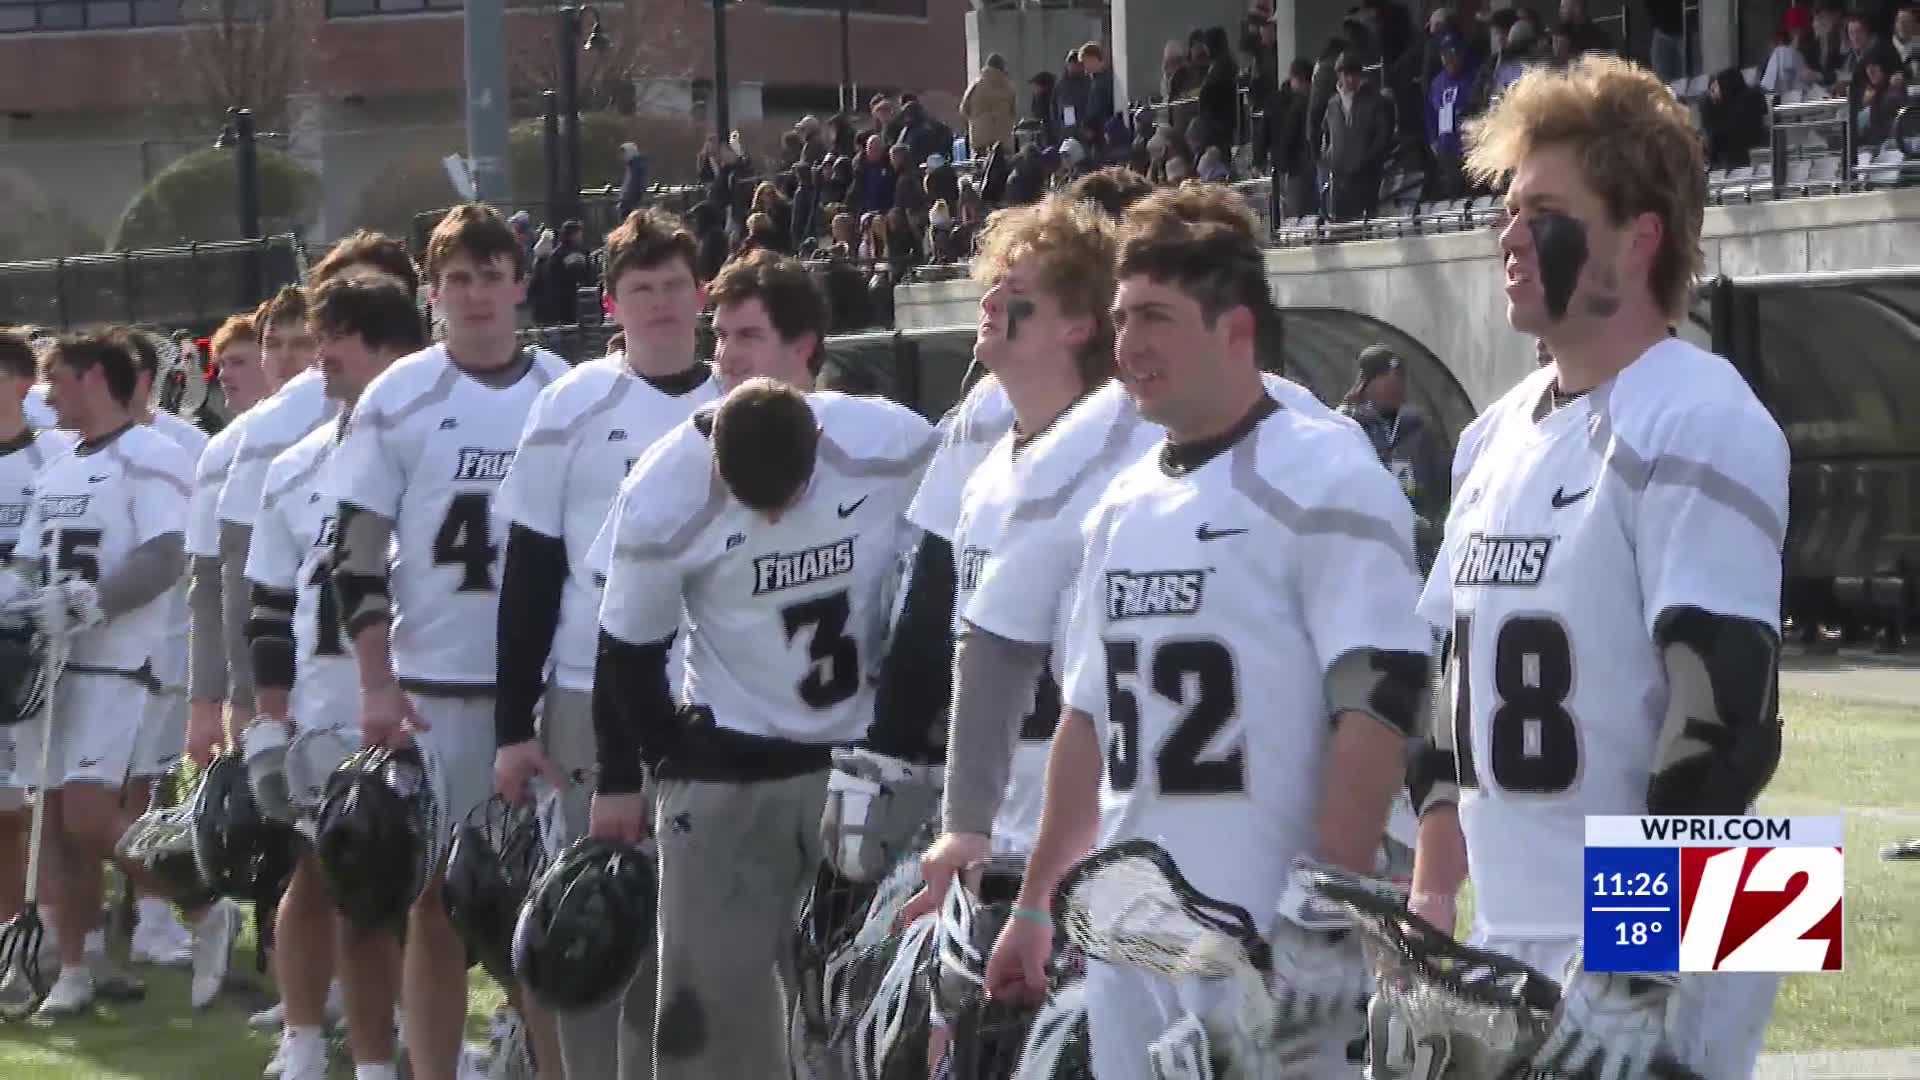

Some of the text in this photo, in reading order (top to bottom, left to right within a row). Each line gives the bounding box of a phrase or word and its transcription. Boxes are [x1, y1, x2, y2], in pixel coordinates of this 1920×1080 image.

[433, 493, 497, 592] 4
[753, 537, 854, 594] FRIARS
[1457, 535, 1550, 586] FRIARS
[1107, 570, 1203, 620] FRIARS
[781, 589, 860, 708] 3
[1104, 640, 1246, 794] 52
[1453, 616, 1579, 793] 18
